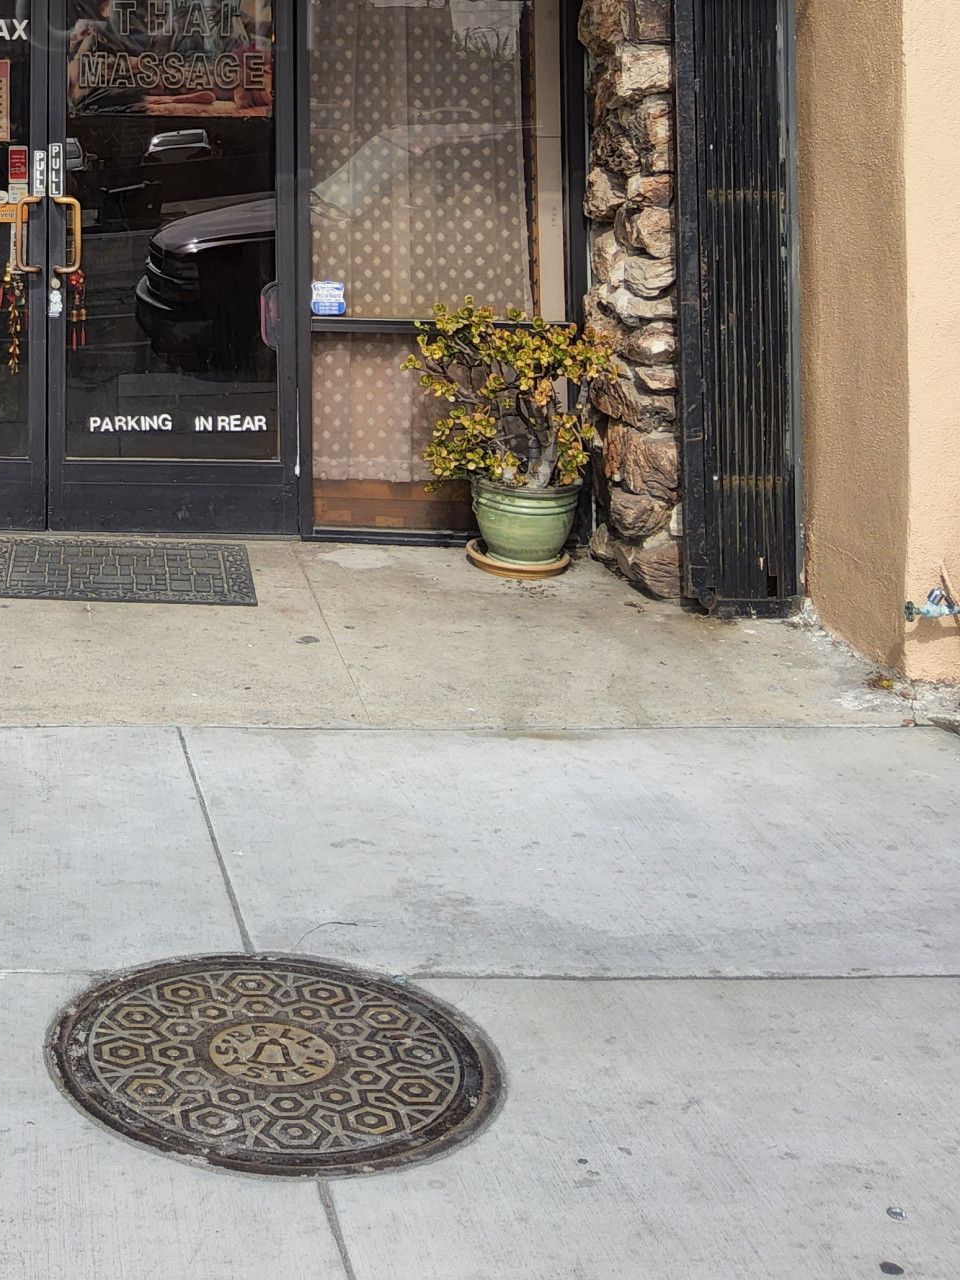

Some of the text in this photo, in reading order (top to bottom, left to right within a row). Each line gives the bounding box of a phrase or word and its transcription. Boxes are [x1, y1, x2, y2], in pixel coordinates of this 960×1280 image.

[112, 0, 234, 37] THAI
[78, 51, 266, 90] MASSAGE
[35, 151, 44, 189] PULL
[52, 145, 60, 195] PULL
[89, 413, 268, 432] PARKING IN REAR
